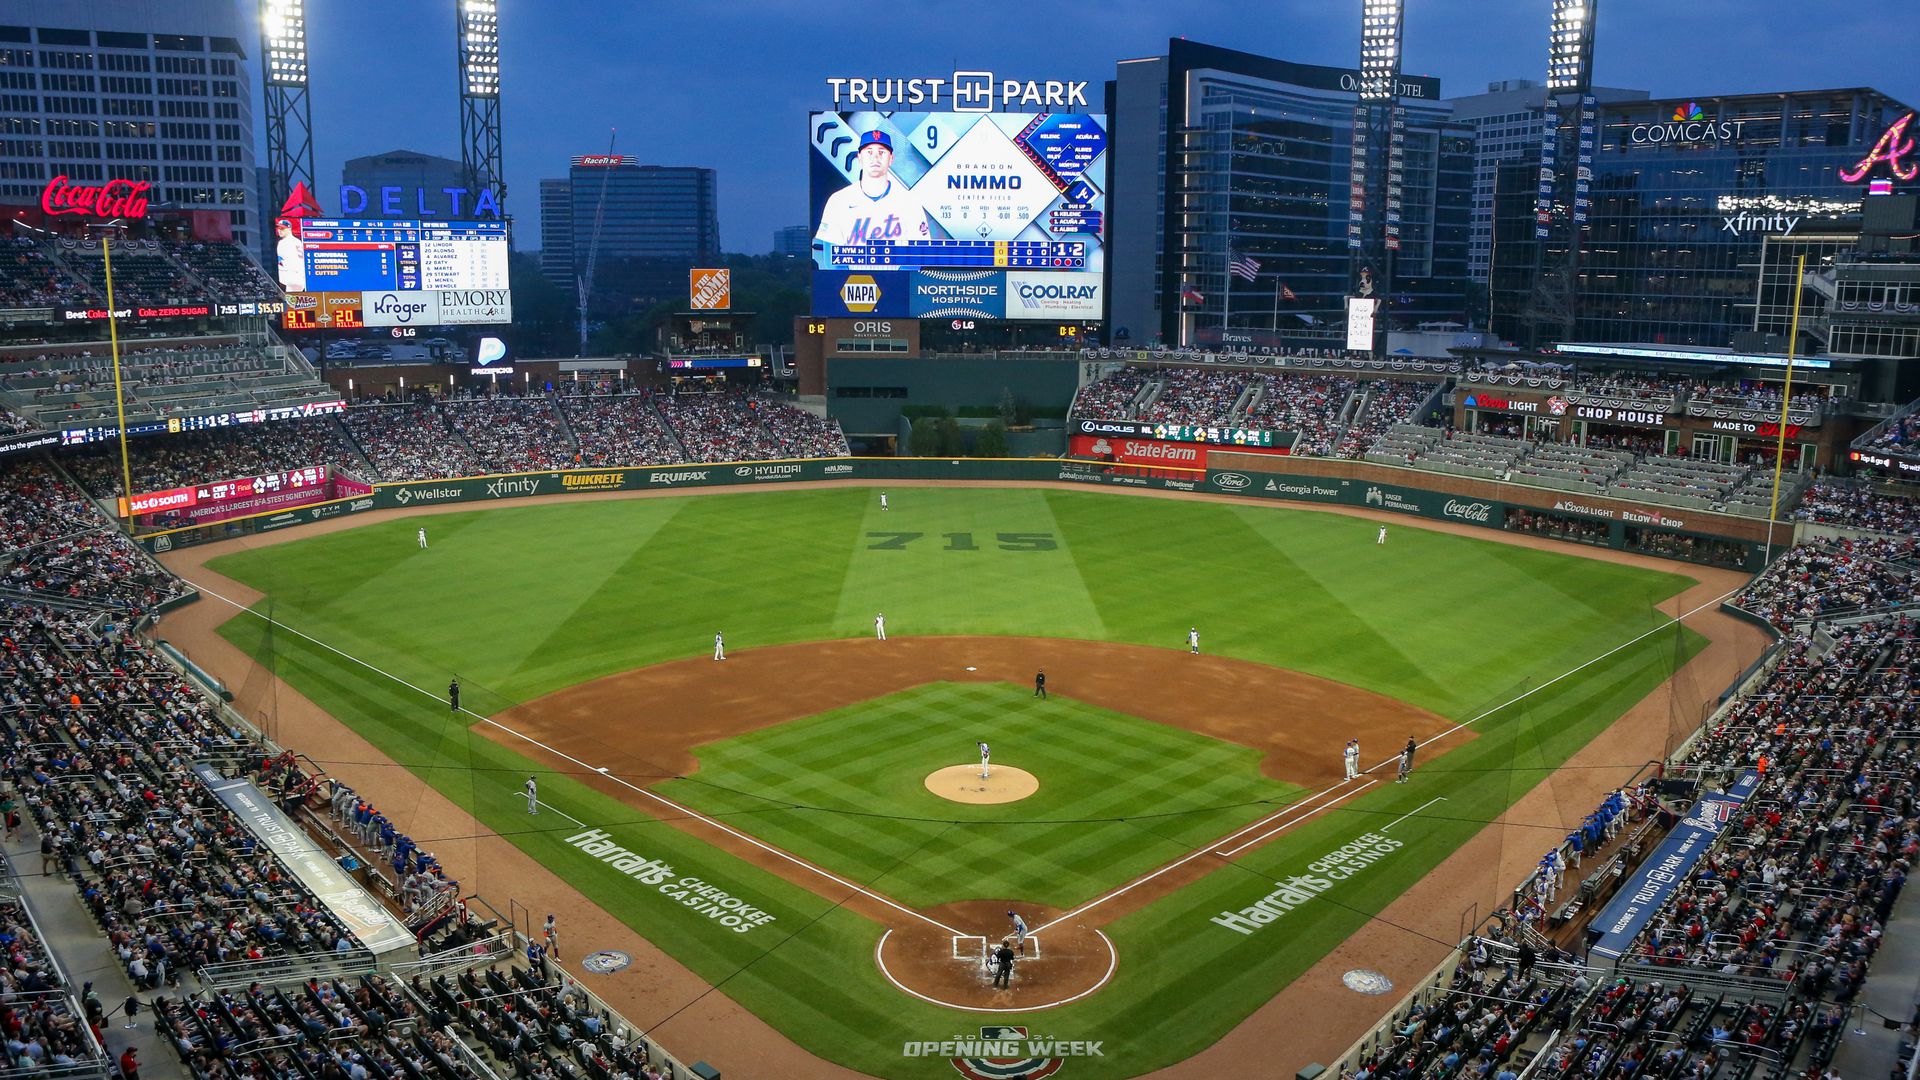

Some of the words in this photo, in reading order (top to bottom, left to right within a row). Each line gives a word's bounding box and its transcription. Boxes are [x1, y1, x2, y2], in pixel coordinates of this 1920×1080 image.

[826, 78, 945, 104] TRUIST
[1003, 80, 1089, 106] PARK
[927, 125, 938, 149] 9
[1631, 121, 1745, 143] COMCAST
[1543, 142, 1555, 150] 2002
[947, 175, 1021, 189] NIMMO
[41, 175, 151, 218] Coca-Cola
[340, 185, 500, 217] DELTA
[1575, 213, 1586, 221] 2022
[1722, 211, 1799, 236] xfinity
[846, 214, 902, 245] Mets
[402, 251, 414, 259] 12
[402, 266, 416, 274] 25
[403, 281, 416, 289] 37
[695, 273, 711, 289] THE
[691, 270, 729, 309] HOME
[706, 283, 729, 308] DEPOT
[847, 286, 875, 302] NAPA
[917, 285, 998, 295] NORTHSIDE
[1020, 285, 1098, 299] COOLRAY
[441, 290, 507, 306] EMORY
[66, 311, 87, 320] Best
[87, 309, 107, 319] Coke
[138, 308, 157, 317] Coke
[159, 309, 180, 317] ZERO
[181, 307, 207, 316] SUGAR
[221, 305, 237, 314] 7:55
[258, 303, 284, 314] $15,151
[374, 294, 427, 322] Kroger
[442, 307, 505, 316] HEALTHCARE
[287, 310, 306, 323] 97
[335, 310, 353, 322] 20
[853, 321, 892, 333] ORIS
[962, 321, 975, 329] LG
[403, 328, 416, 336] LG
[1222, 333, 1251, 342] Braves
[1508, 401, 1538, 412] LIGHT
[1577, 406, 1612, 420] CHOP
[1617, 410, 1663, 425] HOUSE
[1095, 424, 1135, 433] LEXUS
[1141, 426, 1153, 434] NL
[1713, 421, 1740, 431] MADE
[1742, 423, 1755, 433] TO
[1757, 421, 1801, 439] Chll
[27, 440, 41, 449] game
[42, 437, 59, 446] faster.
[1875, 458, 1884, 466] go
[755, 465, 801, 475] HYUNDAI
[266, 480, 280, 488] NYY
[562, 473, 624, 487] QUIKRETE
[650, 471, 708, 485] EQUIFAX
[1219, 475, 1245, 487] Ford
[237, 484, 252, 492] Final
[486, 477, 540, 497] xfinity
[1279, 483, 1311, 496] Georgia
[1312, 486, 1338, 496] Power
[159, 493, 188, 506] SOUTH
[198, 489, 210, 499] AL
[213, 491, 226, 499] CLE
[413, 488, 462, 500] Wellstar
[1385, 493, 1402, 501] KAISER
[189, 506, 225, 518] AMERICA'S
[226, 501, 254, 512] LARGEST
[294, 488, 323, 500] NETWORK
[1384, 501, 1419, 511] PERMANENTE
[1564, 501, 1589, 514] Coors
[1590, 508, 1614, 518] LIGHT
[1443, 499, 1492, 522] Coca-Cola
[1622, 511, 1650, 523] BELOW
[1661, 517, 1684, 528] CHOP
[865, 532, 1058, 551] 715
[254, 812, 284, 838] TRUIST
[285, 840, 310, 861] PARK
[1307, 832, 1385, 873] CHEROKEE
[1327, 838, 1404, 880] CASINOS
[1610, 911, 1633, 935] WELCOME
[1631, 880, 1664, 906] TRUIST
[1659, 854, 1685, 873] PARK
[658, 883, 756, 934] CASINOS
[679, 877, 777, 927] CHEROKEE
[903, 1040, 1019, 1057] OPENING
[1027, 1040, 1105, 1057] WEEK
